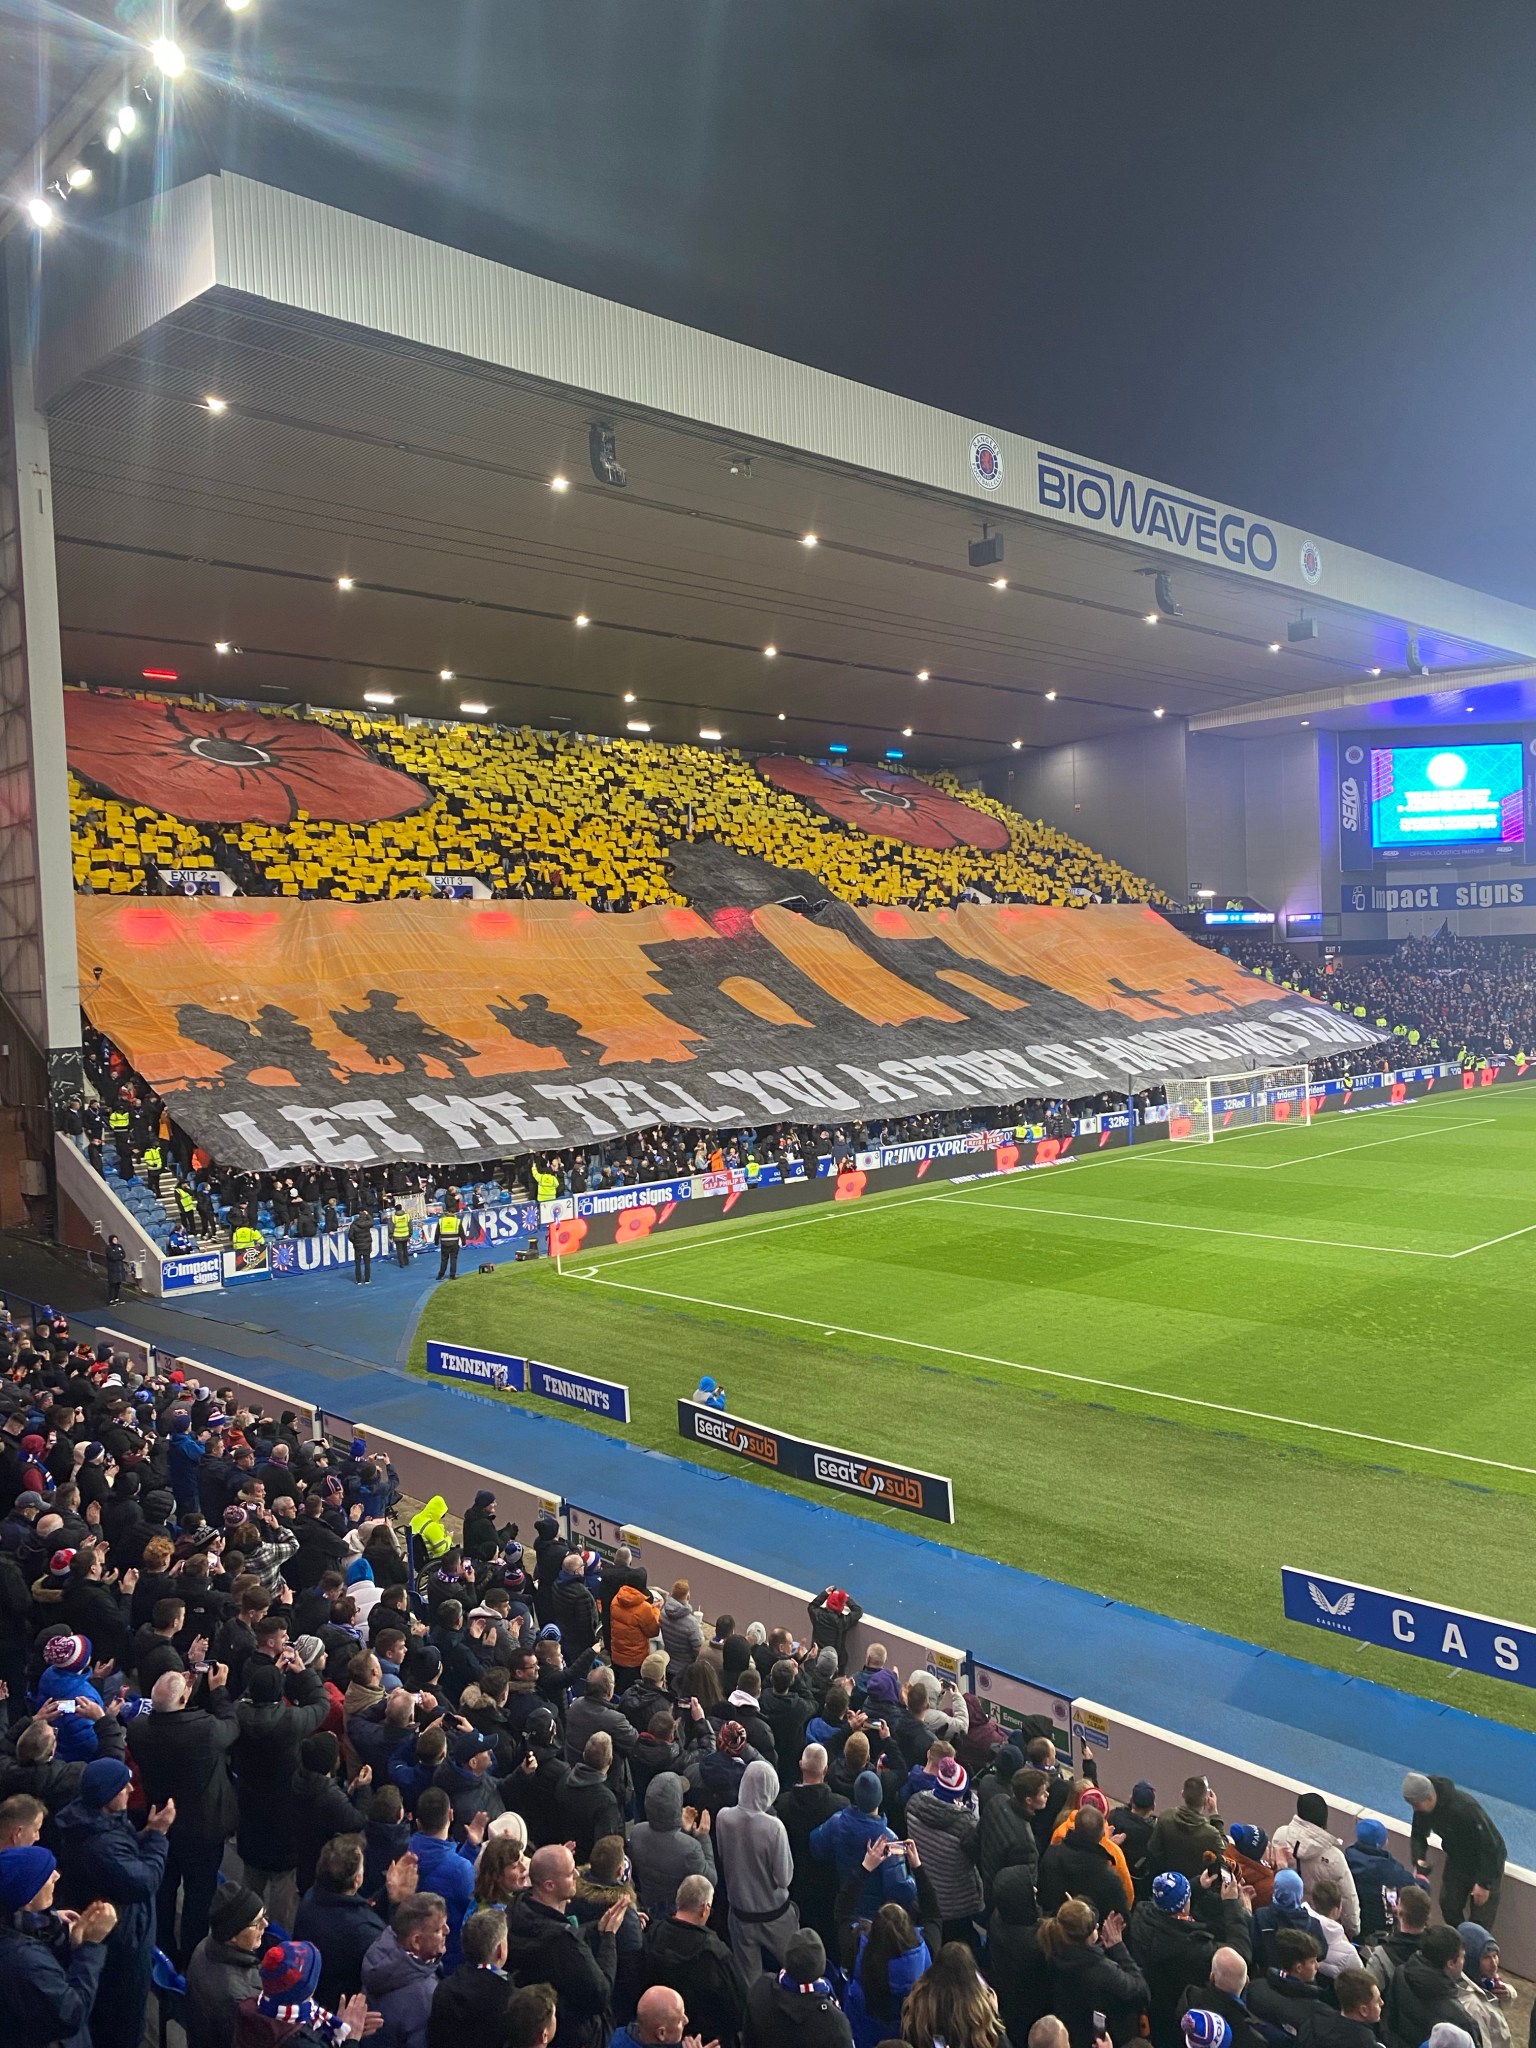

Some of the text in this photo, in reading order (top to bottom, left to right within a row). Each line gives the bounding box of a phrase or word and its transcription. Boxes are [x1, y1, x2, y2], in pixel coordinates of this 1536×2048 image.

[1038, 451, 1278, 571] BIOWAVEGO
[1342, 777, 1358, 831] SEKO
[171, 871, 208, 881] EXIT 2
[434, 876, 463, 885] EXIT 3
[1371, 883, 1524, 911] Impact signs
[1276, 1088, 1298, 1100] trident
[1308, 1085, 1326, 1097] rident
[219, 1100, 424, 1168] LET
[406, 1091, 564, 1149] ME
[531, 1077, 745, 1135] TELL
[835, 1064, 918, 1103] A
[878, 1049, 1064, 1095] STORY
[1025, 1044, 1109, 1080] OF
[1223, 1097, 1246, 1110] 32Red
[1109, 1116, 1129, 1129] 32Re
[875, 1152, 880, 1160] 3
[884, 1141, 967, 1166] RHINO EXPRE
[566, 1200, 571, 1208] 2
[593, 1187, 673, 1214] Impact signs
[177, 1258, 219, 1276] Impact
[193, 1272, 218, 1284] signs
[440, 1352, 509, 1380] TENNENT'S
[543, 1374, 610, 1410] TENNENT'S
[699, 1419, 775, 1459] seat sub
[820, 1460, 919, 1501] seat sub
[588, 1519, 603, 1540] 31
